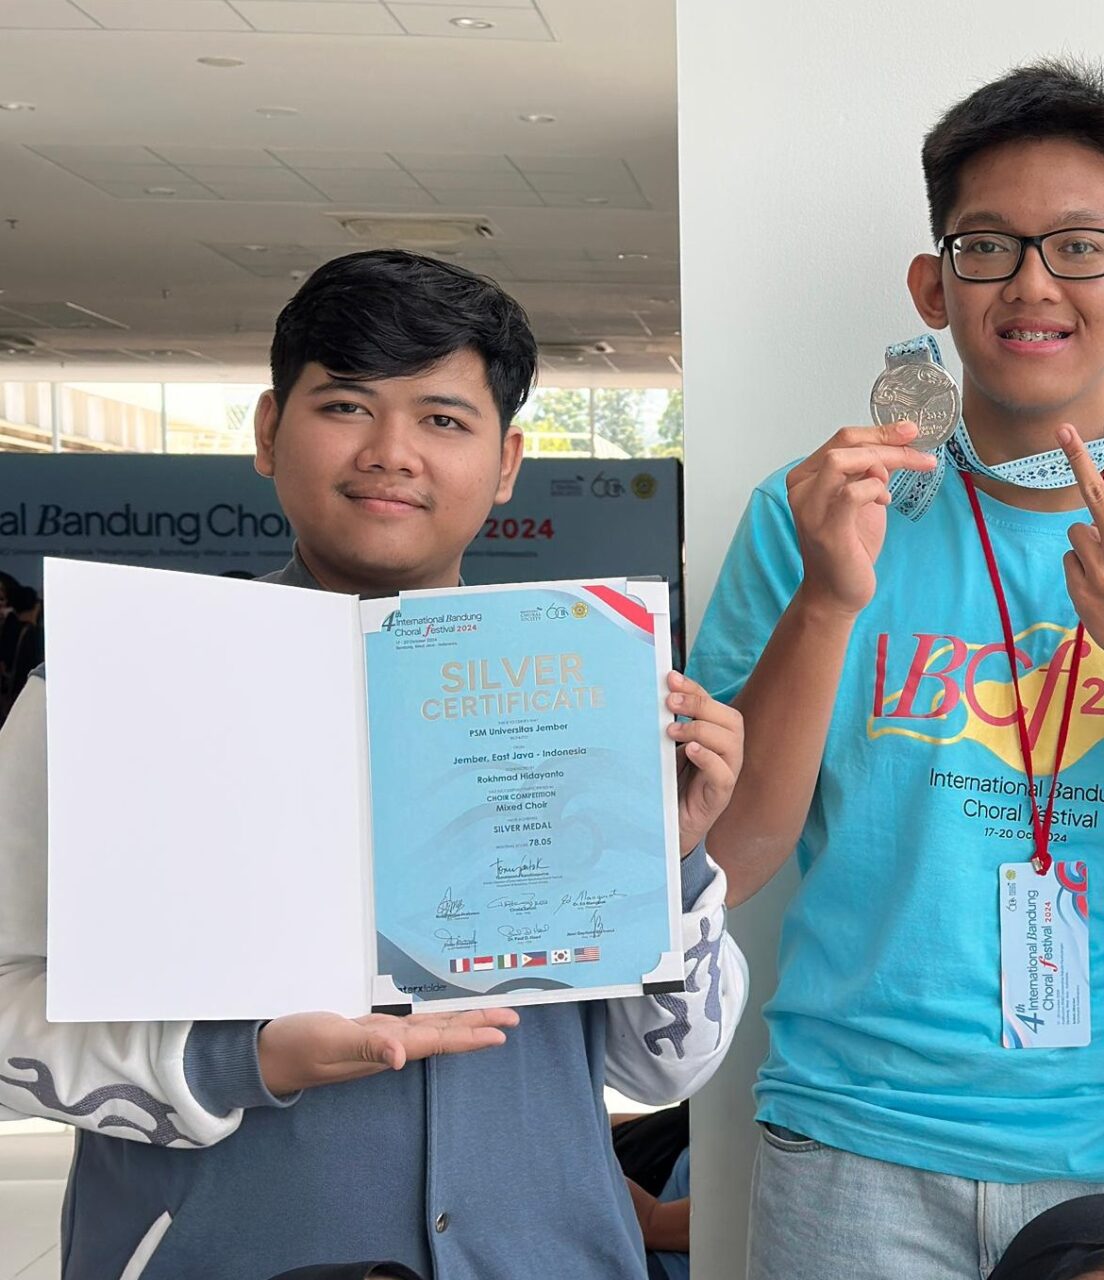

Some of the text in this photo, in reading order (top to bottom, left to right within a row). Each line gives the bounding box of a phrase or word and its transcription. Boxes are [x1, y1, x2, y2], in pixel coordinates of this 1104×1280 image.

[35, 504, 200, 545] Bandung
[485, 518, 554, 539] 2024
[396, 615, 444, 627] International
[446, 612, 482, 623] Bandung
[395, 624, 477, 637] Choral festival 2024
[440, 653, 585, 694] SILVER
[420, 687, 607, 721] CERTIFICATE
[469, 728, 487, 737] PSM
[489, 725, 534, 736] Universitas
[535, 722, 568, 732] Jember
[453, 747, 587, 765] Jember, East Java Indonesia
[477, 770, 564, 784] Rokhmad Hidayanto
[929, 768, 1043, 798] International
[487, 791, 556, 802] CHOIR COMPETITION
[496, 801, 548, 812] Mixed Choir
[963, 799, 1022, 822] Choral
[493, 822, 552, 833] SILVER MEDAL
[984, 827, 1014, 840] 17-20
[529, 838, 552, 847] 78.05
[1027, 889, 1039, 941] Bandung
[1038, 901, 1058, 1012] Choral festival 2024
[1026, 943, 1038, 1011] International
